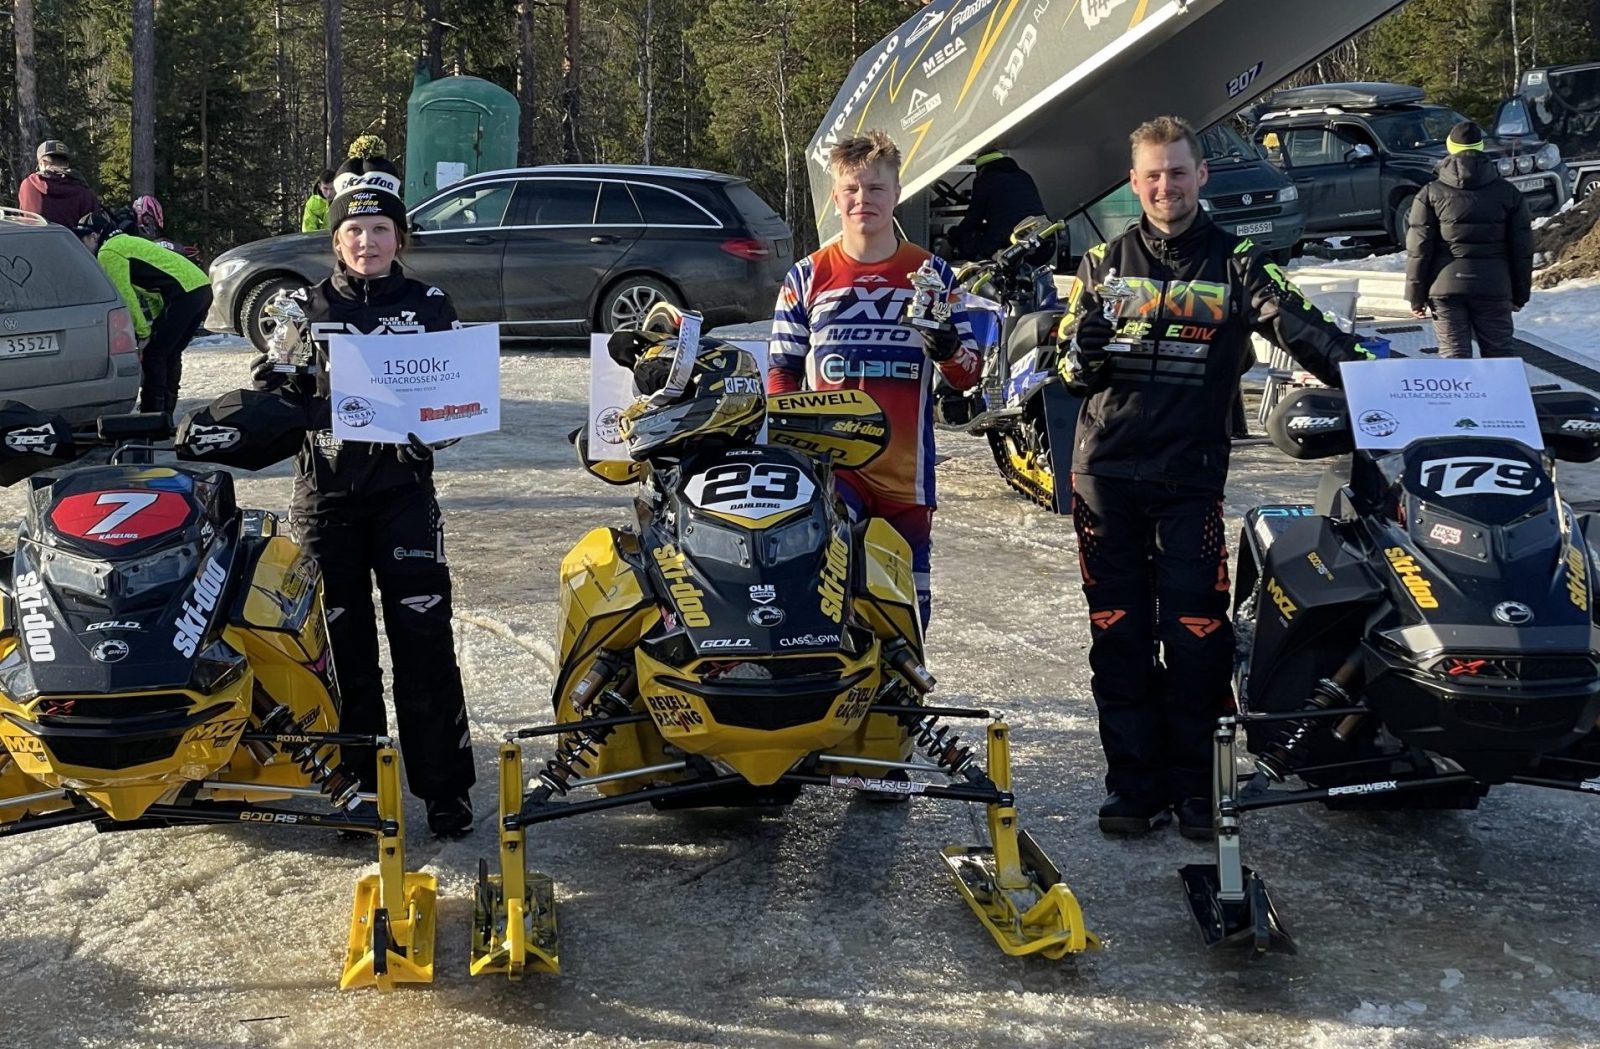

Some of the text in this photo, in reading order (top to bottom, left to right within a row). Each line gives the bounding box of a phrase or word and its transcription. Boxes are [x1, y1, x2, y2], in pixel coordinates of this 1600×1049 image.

[922, 36, 966, 73] MECA
[1229, 64, 1259, 97] 207
[401, 311, 416, 322] 7
[826, 328, 911, 341] MOTO
[8, 337, 53, 351] 35527
[383, 357, 450, 375] 1500kr
[370, 371, 461, 385] HULTACROSSEN 2024
[1400, 378, 1473, 392] 1500kr
[777, 392, 862, 410] ENWELL
[1464, 391, 1488, 399] 2024
[832, 421, 885, 437] ski-doo
[701, 464, 800, 506] 23
[1424, 462, 1538, 492] 179
[730, 502, 780, 510] DAHLBERG
[85, 493, 159, 536] 7
[652, 544, 712, 628] ski-doo
[817, 532, 850, 624] ski-doo
[1383, 546, 1439, 610] ski-doo
[172, 557, 226, 659] ski-doo
[17, 571, 56, 663] ski-doo
[700, 638, 752, 648] GOLD.
[780, 634, 841, 647] CLASS GYM
[276, 734, 310, 744] ROTAX
[1328, 780, 1397, 796] SPEEDWERX
[240, 811, 298, 823] 600RS
